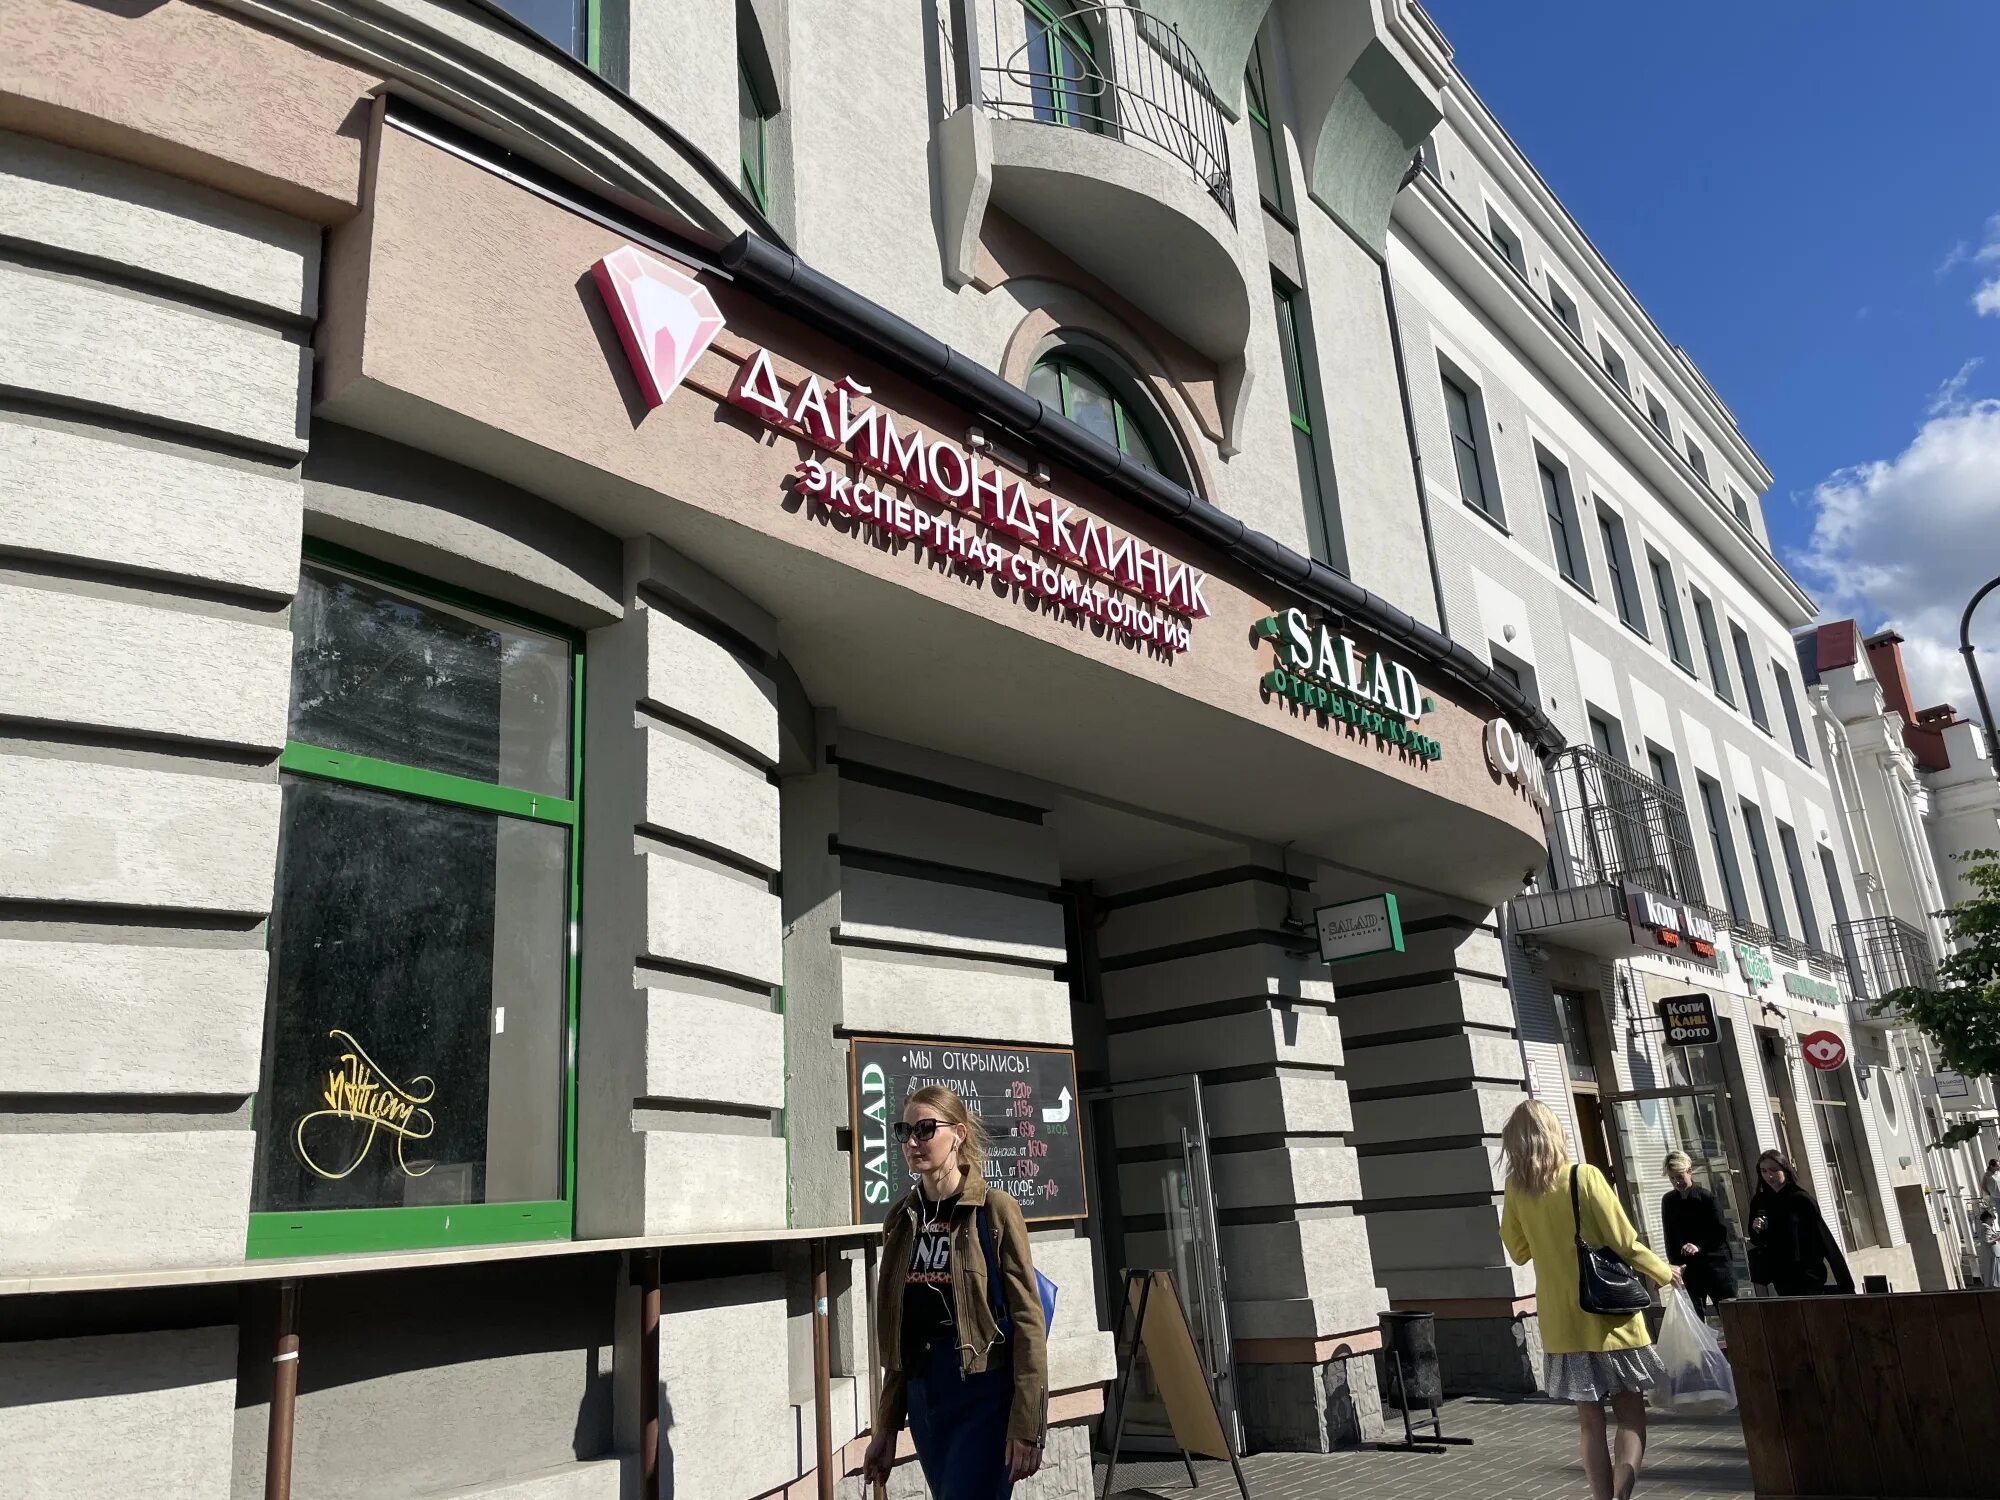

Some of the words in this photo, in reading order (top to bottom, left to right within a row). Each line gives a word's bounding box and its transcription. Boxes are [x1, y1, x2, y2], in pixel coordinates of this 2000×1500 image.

[739, 347, 1211, 618] ДАЙМОНД-КЛИНИК
[804, 459, 1002, 571] ЭКСПЕРТНАЯ
[1010, 554, 1191, 652] СТОМАТОЛОГИЯ
[1287, 606, 1423, 720] SALAD
[1273, 668, 1384, 735] ОТКРЫТАЯ
[1389, 718, 1443, 761] КУХНЯ
[1327, 913, 1379, 936] SALAD
[909, 1049, 932, 1070] МЫ
[942, 1050, 1031, 1073] ОТКРЫЛИСЬ!
[861, 1062, 890, 1205] SALAD
[1046, 1124, 1069, 1136] ВХОД
[1007, 1179, 1035, 1197] КОФЕ
